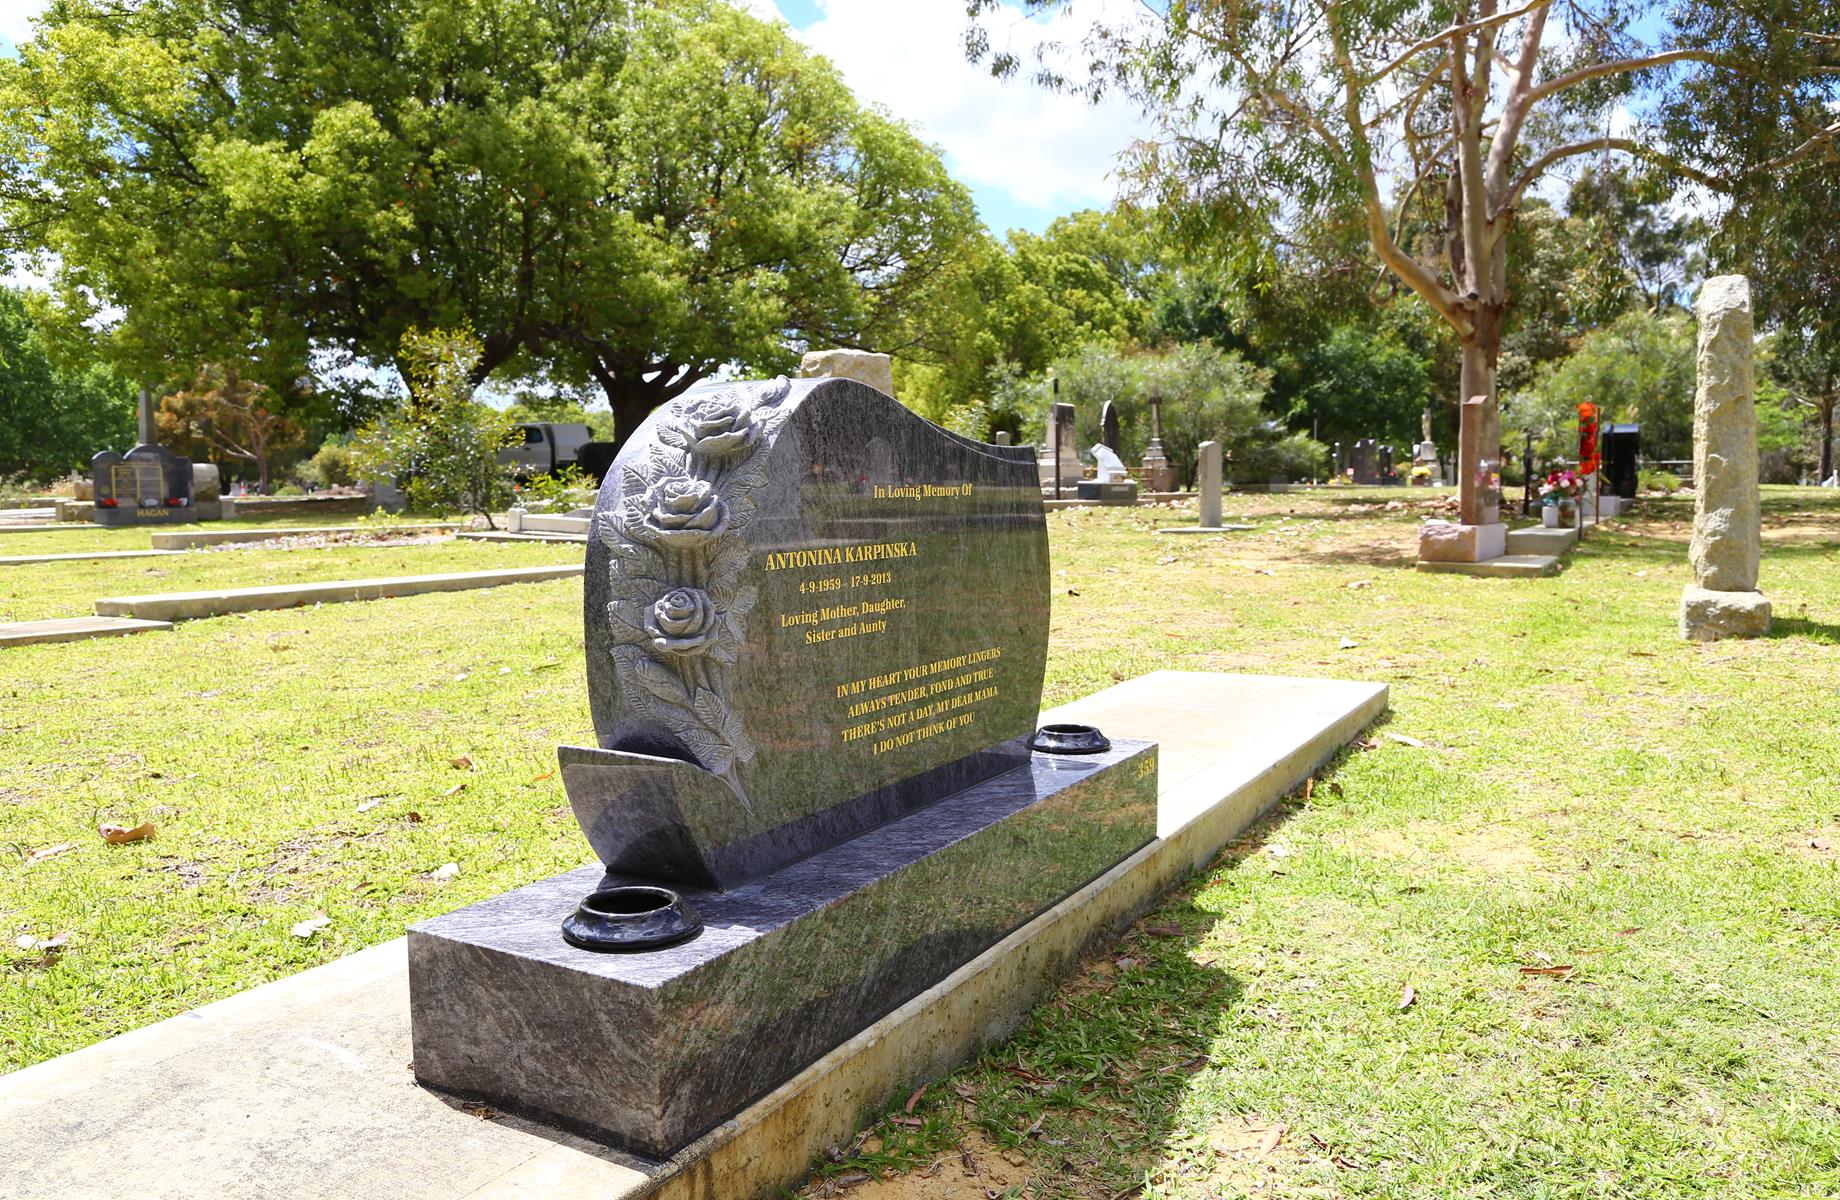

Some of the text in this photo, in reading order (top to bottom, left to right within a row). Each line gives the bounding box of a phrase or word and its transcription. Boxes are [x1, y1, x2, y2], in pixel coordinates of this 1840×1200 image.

[873, 483, 973, 501] In Loving Memory Of
[137, 508, 169, 517] HAGAN
[764, 541, 917, 571] ANTONINA KARPINSKA
[799, 577, 841, 594] 4-9-1959
[851, 571, 891, 588] 17-9-2013
[781, 610, 818, 627] Loving
[820, 604, 860, 621] Mother,
[805, 619, 887, 645] Sister and Aunty
[836, 646, 1001, 698] IN MY HEART YOUR MEMORY LINGERS
[847, 667, 994, 719] ALWAYS TENDER, FOND AND TRUE
[842, 685, 999, 742] THERE'S NOT A DAY, MY DEAR MAMA
[874, 711, 976, 755] I DO NOT THINK OF YOU
[1138, 756, 1155, 779] 359
